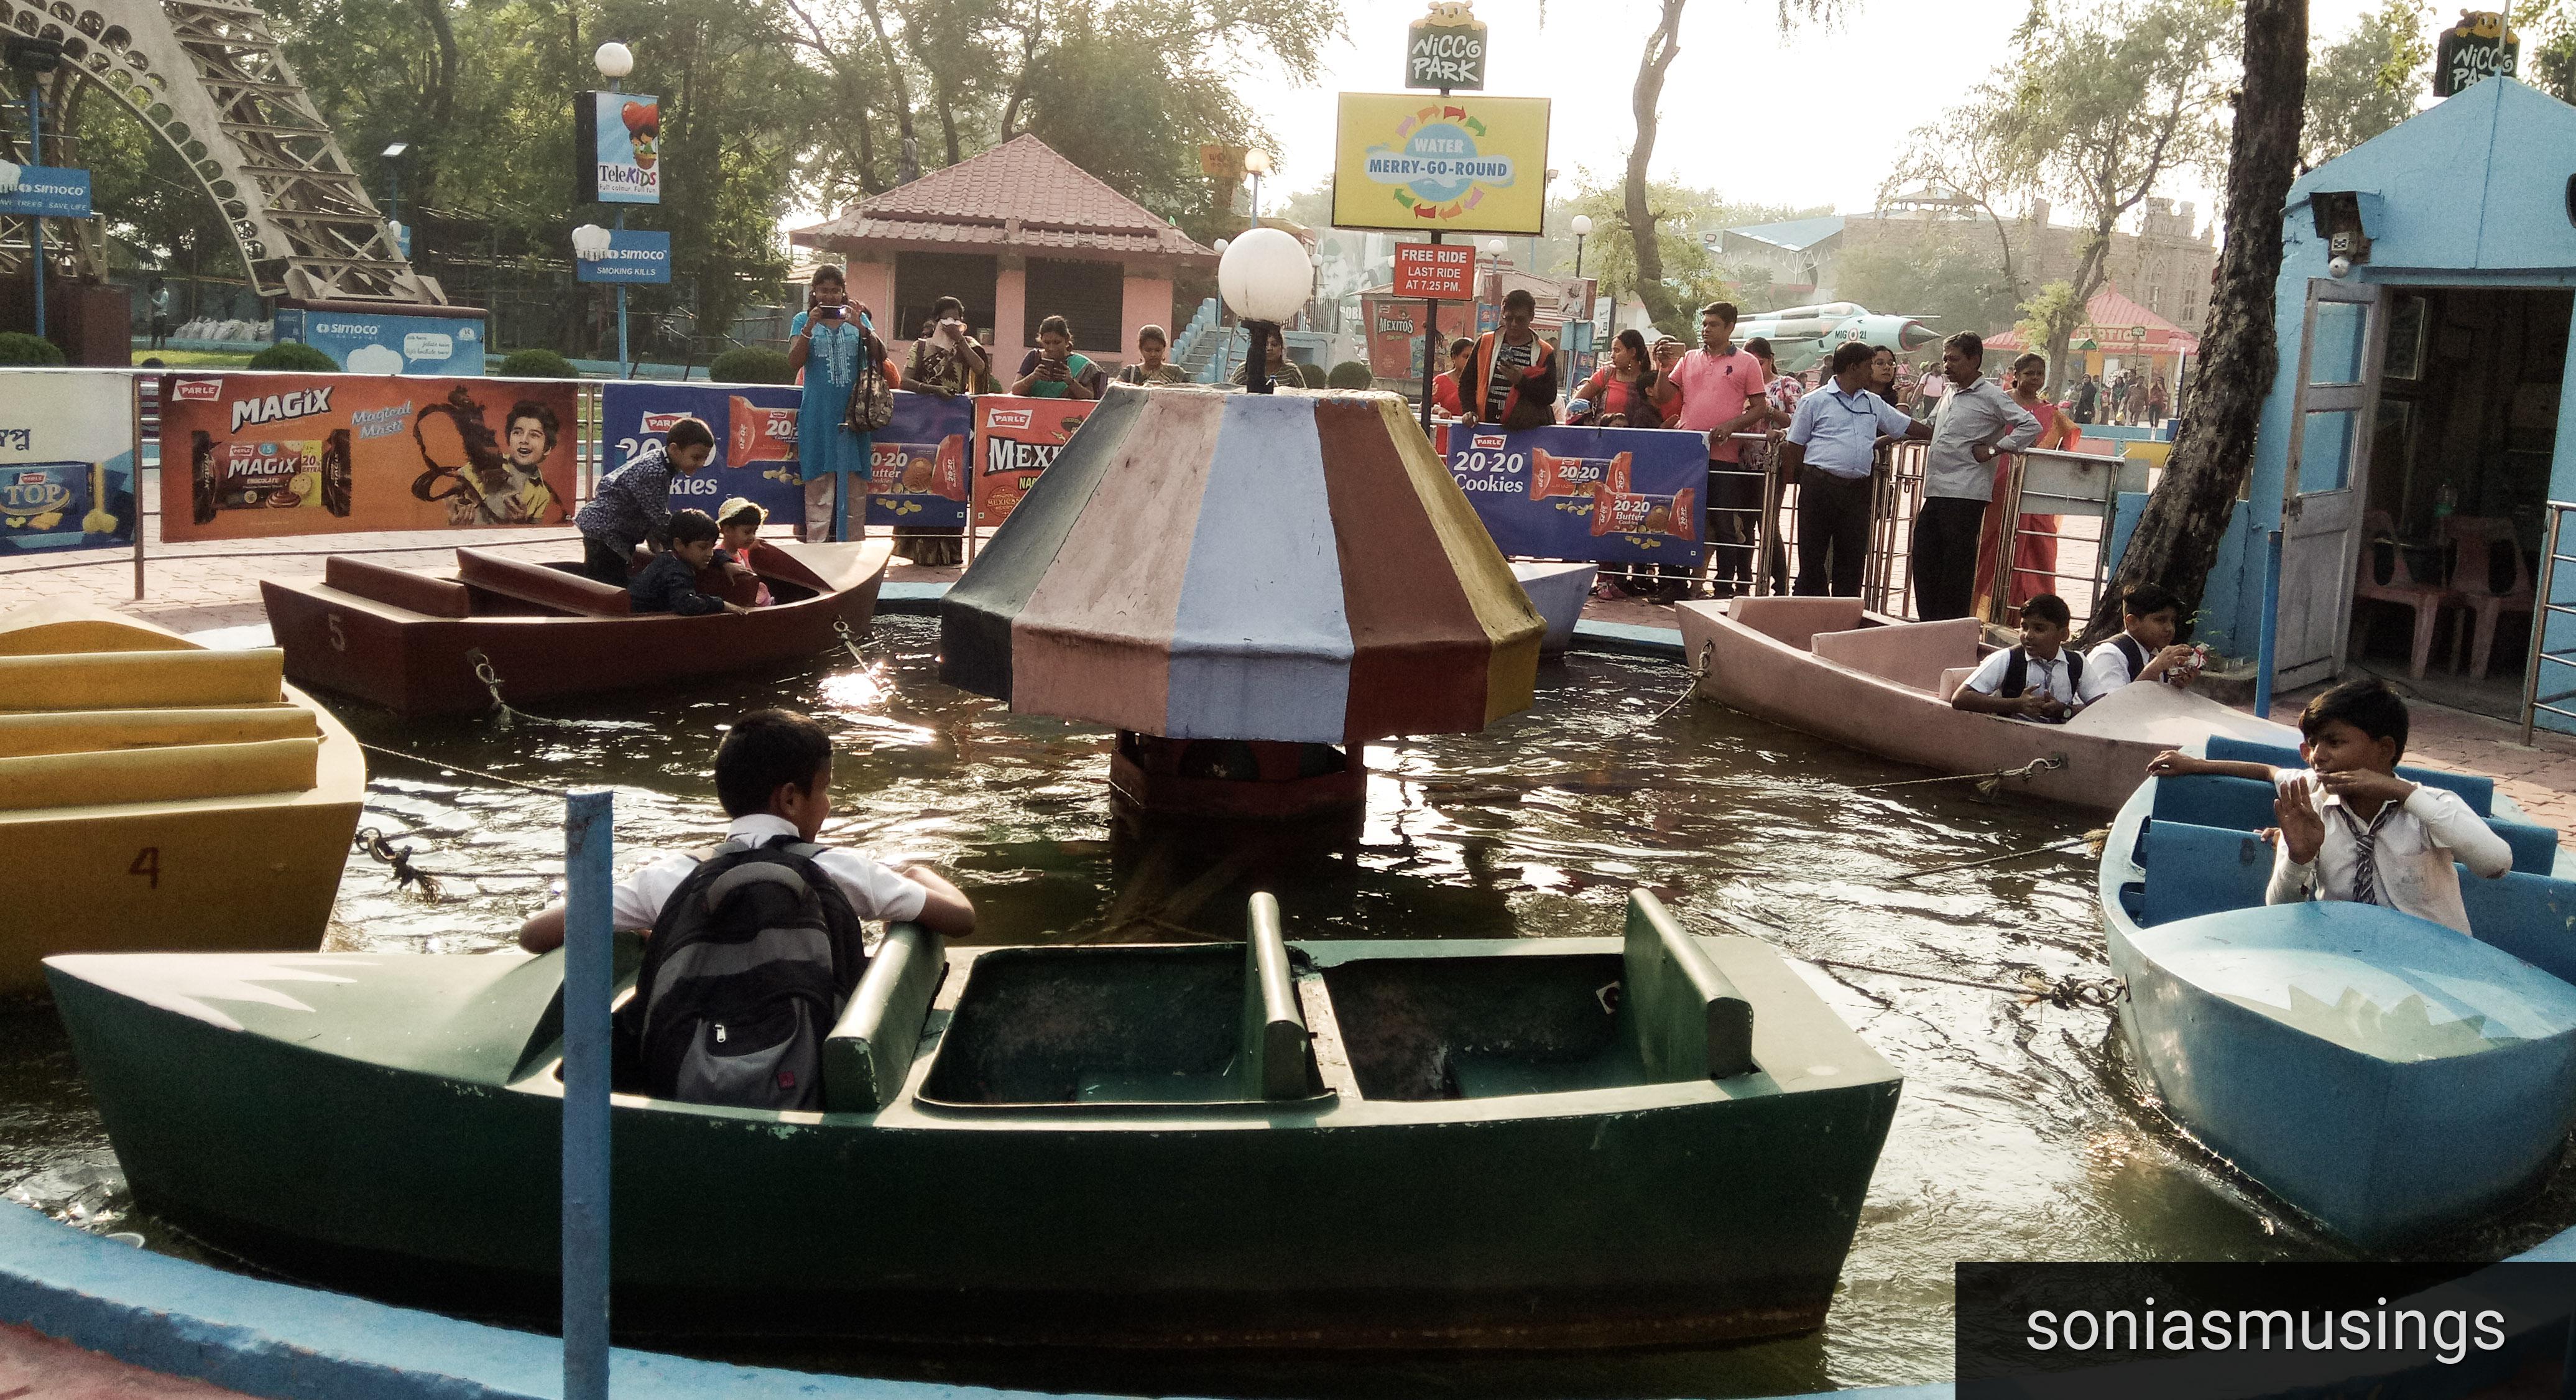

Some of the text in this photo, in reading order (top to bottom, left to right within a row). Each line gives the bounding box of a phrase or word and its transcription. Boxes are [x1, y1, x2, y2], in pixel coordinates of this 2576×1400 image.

[1412, 56, 1479, 81] PARK
[2453, 67, 2489, 90] PA
[1415, 139, 1464, 153] WATER
[1369, 159, 1507, 177] MERRY-GO-ROUND
[1401, 249, 1467, 264] FREE RIDE
[597, 267, 633, 275] SMOKING
[1408, 266, 1461, 279] LAST RIDE
[1406, 279, 1461, 292] AT 7.25 PM.
[1378, 317, 1413, 334] MEXITOS
[1835, 330, 1847, 339] MIG
[182, 385, 216, 395] PARLE
[351, 400, 412, 425] Magical
[995, 415, 1027, 423] PARLE
[650, 419, 675, 427] PAR
[870, 452, 908, 467] 0-20
[1454, 451, 1524, 473] 20-20
[872, 468, 901, 478] utter
[1557, 465, 1600, 480] 20-20
[670, 475, 718, 495] kies
[1454, 473, 1524, 493] Cookies
[4, 484, 62, 505] TOP
[1613, 500, 1650, 512] 20-20
[1616, 511, 1645, 521] Butter
[327, 613, 346, 652] 5
[129, 846, 160, 889] 4
